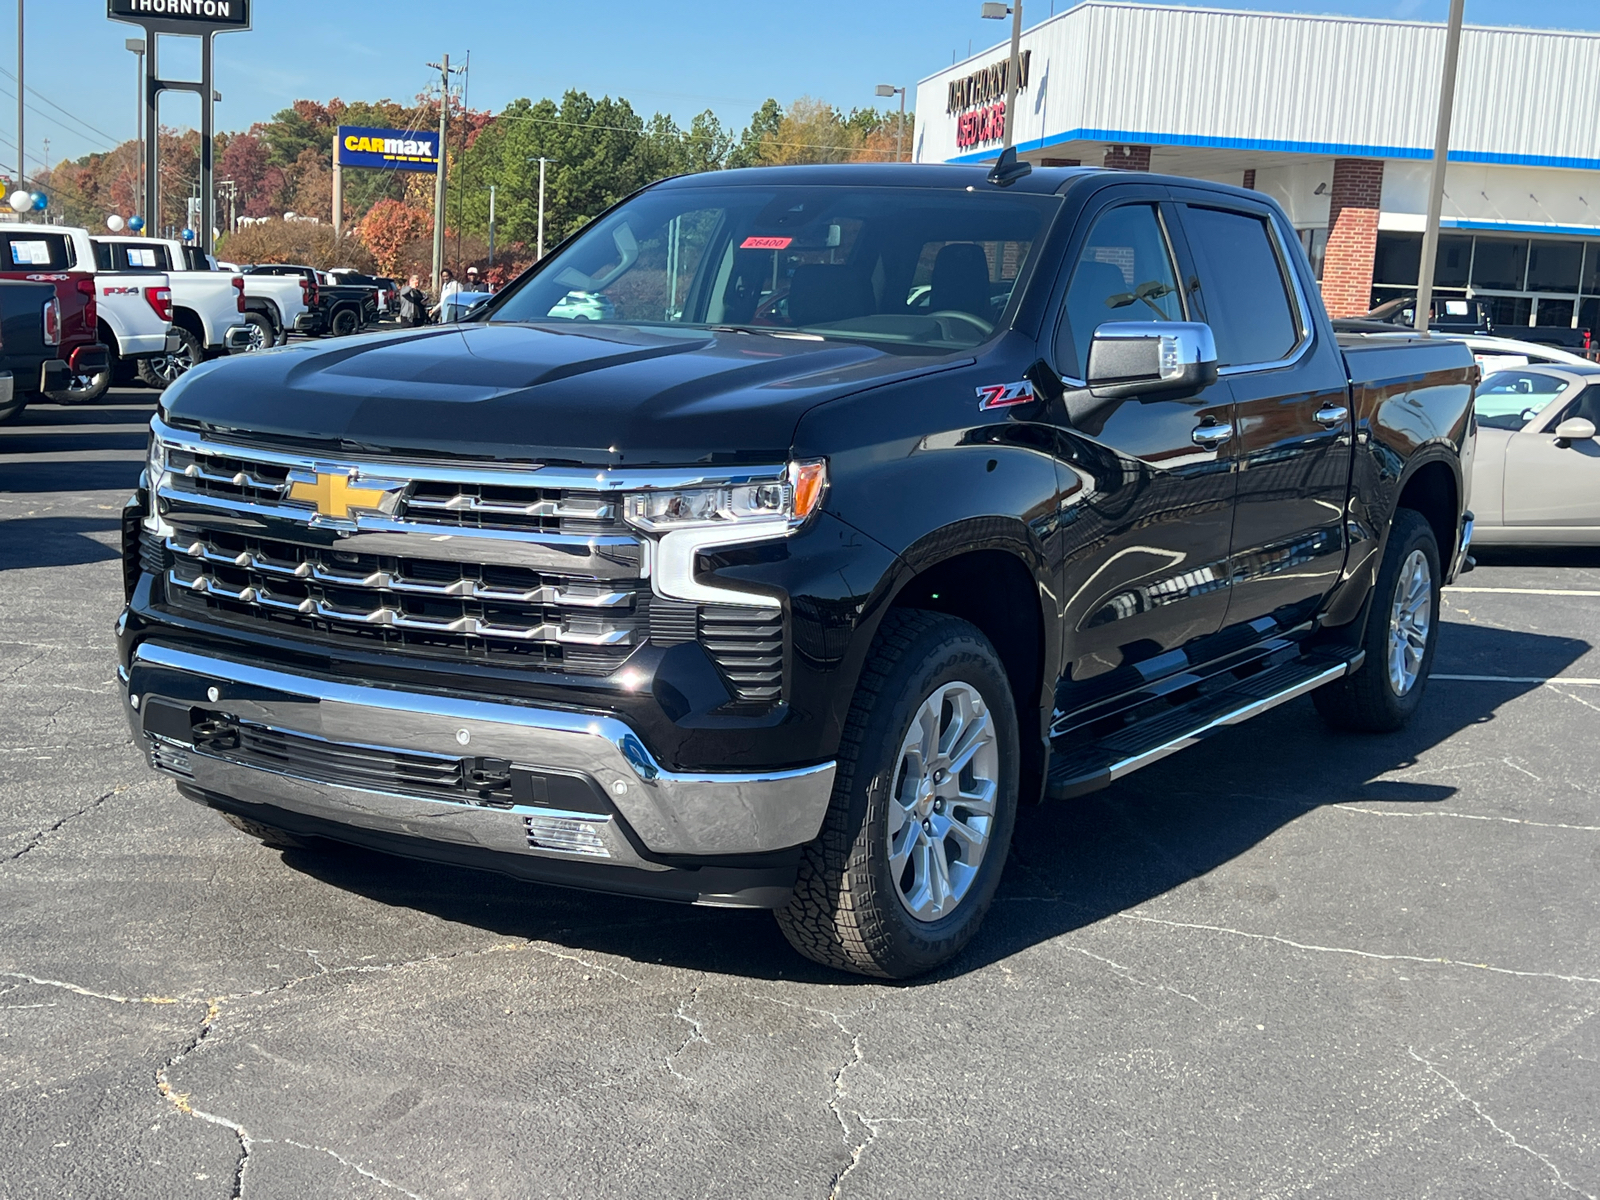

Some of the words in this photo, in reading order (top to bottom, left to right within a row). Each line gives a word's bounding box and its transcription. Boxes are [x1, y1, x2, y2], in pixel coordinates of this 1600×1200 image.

[130, 0, 230, 17] THORNTON
[971, 50, 1031, 106] THORNTN
[748, 239, 784, 247] 26400
[103, 287, 139, 296] FX4
[975, 380, 1034, 411] Z71
